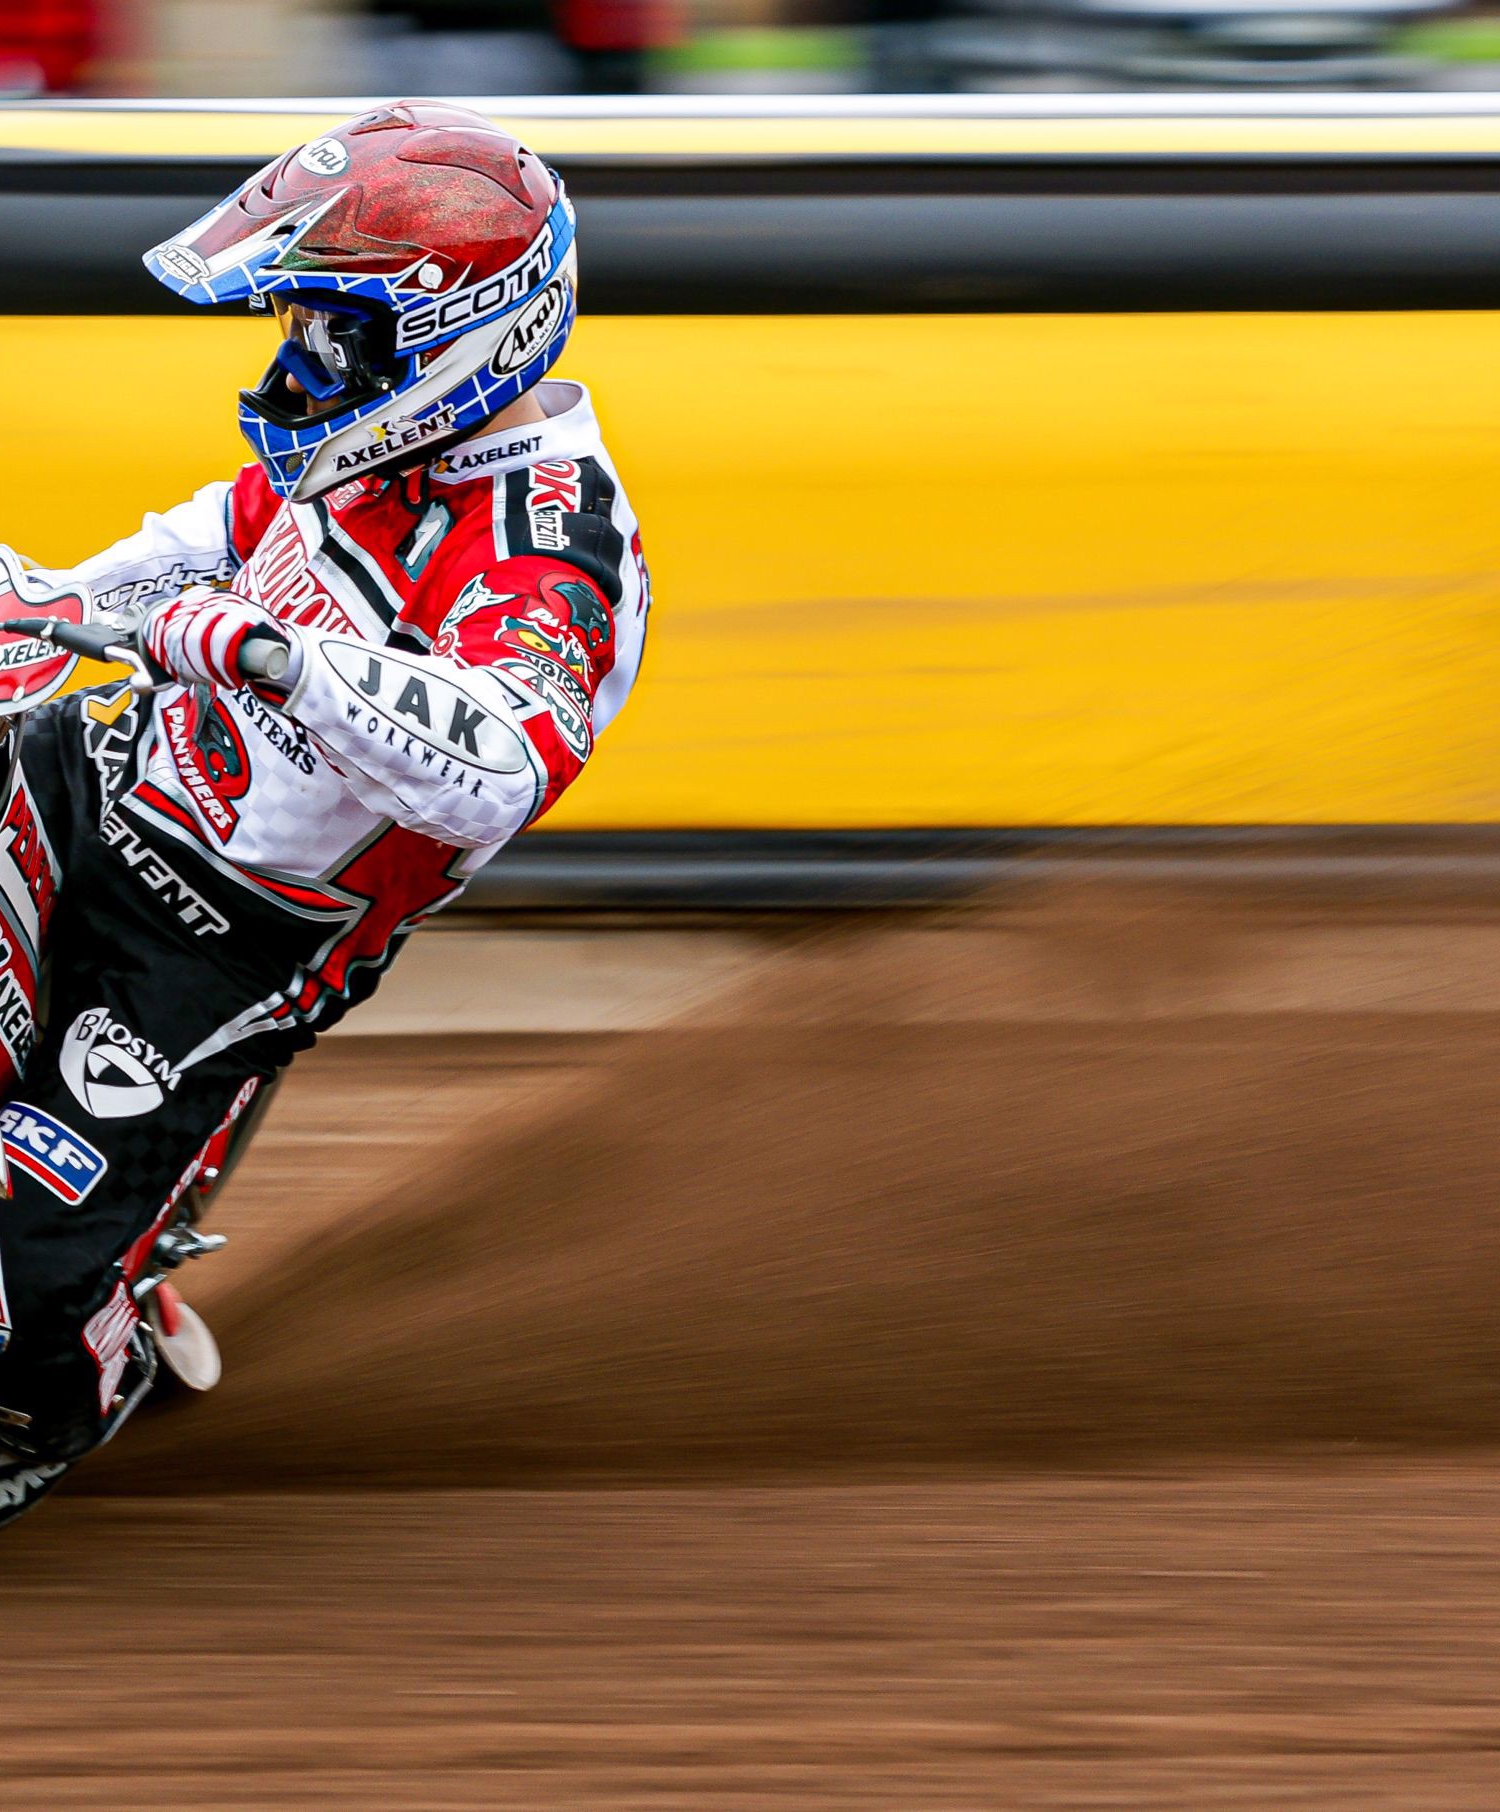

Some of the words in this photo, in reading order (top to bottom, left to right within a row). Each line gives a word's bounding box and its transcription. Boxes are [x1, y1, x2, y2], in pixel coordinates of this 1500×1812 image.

[401, 234, 551, 343] SCOTT
[501, 285, 557, 373] Arai
[336, 407, 452, 472] AXELENT
[459, 436, 543, 470] AXELENT
[533, 510, 567, 549] enzin
[232, 686, 317, 775] YSTEMS
[346, 701, 483, 798] WORKWEAR
[357, 656, 488, 759] JAK
[166, 706, 233, 830] PANTHERS
[75, 1013, 182, 1092] BIOSYM
[0, 1109, 98, 1173] SKF
